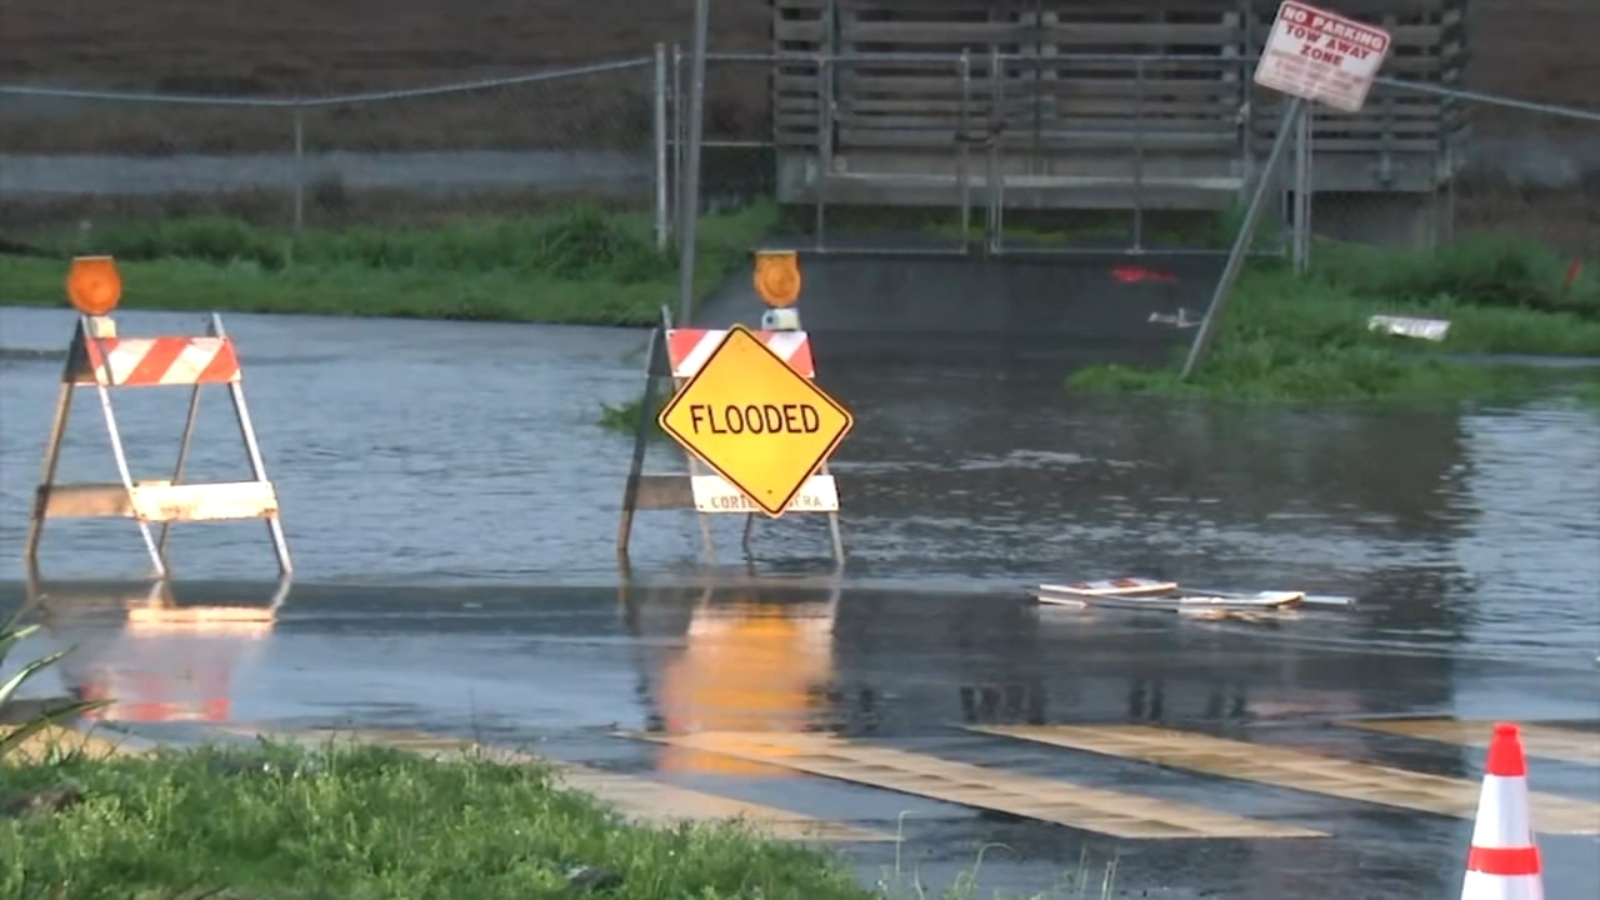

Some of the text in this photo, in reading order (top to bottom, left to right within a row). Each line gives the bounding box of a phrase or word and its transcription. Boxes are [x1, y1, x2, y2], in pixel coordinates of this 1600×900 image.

[1283, 7, 1383, 50] NO PARKING
[1286, 25, 1370, 60] TOW AWAY
[1301, 45, 1344, 66] ZONE
[690, 404, 820, 434] FLOODED
